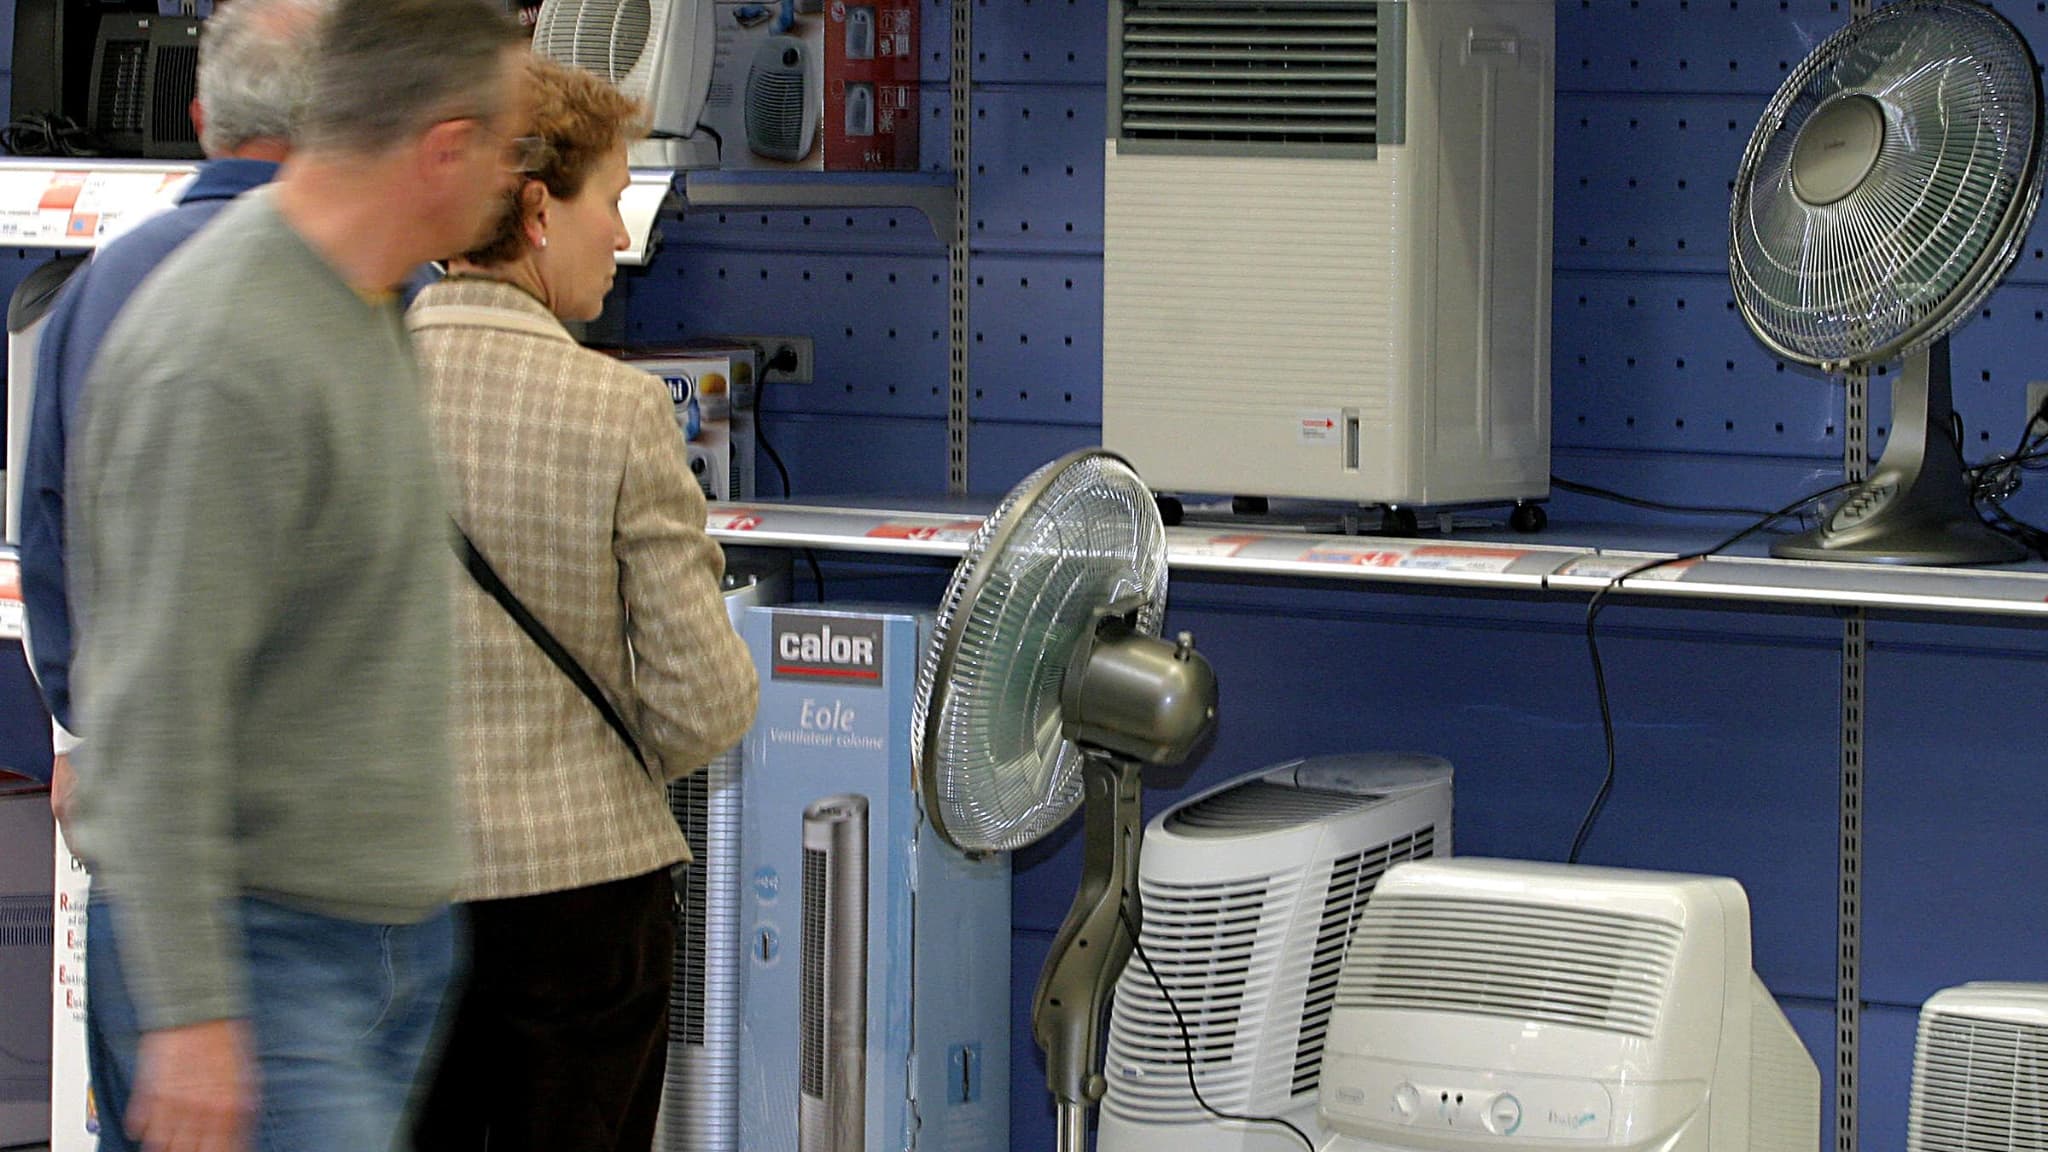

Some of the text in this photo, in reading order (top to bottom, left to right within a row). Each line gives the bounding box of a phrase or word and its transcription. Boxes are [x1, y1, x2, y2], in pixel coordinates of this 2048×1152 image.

[801, 699, 855, 730] Eole
[771, 727, 883, 749] Ventilateur colonne
